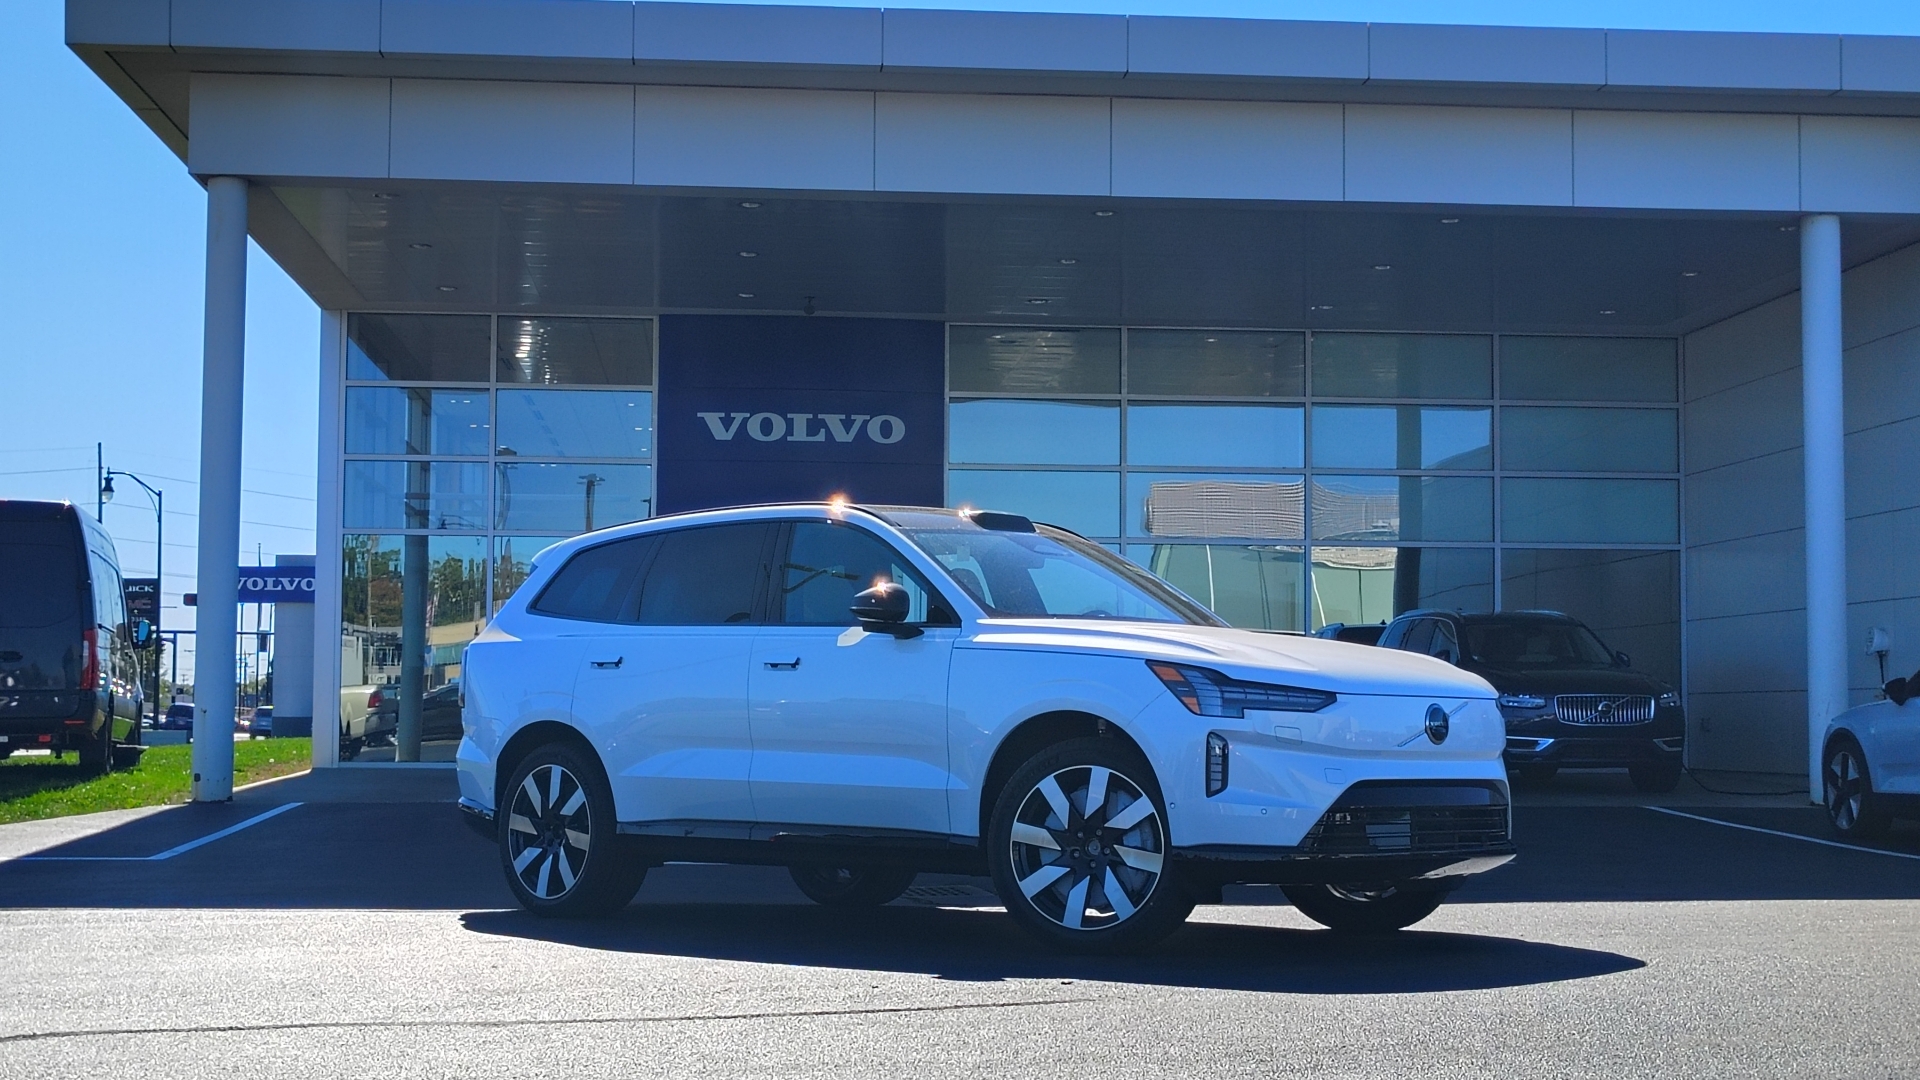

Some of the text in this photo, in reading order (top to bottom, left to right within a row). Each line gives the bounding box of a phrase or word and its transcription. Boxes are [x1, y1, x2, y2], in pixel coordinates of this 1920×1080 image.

[697, 412, 906, 444] VOLVO
[125, 584, 154, 593] UICK
[127, 599, 152, 609] MC
